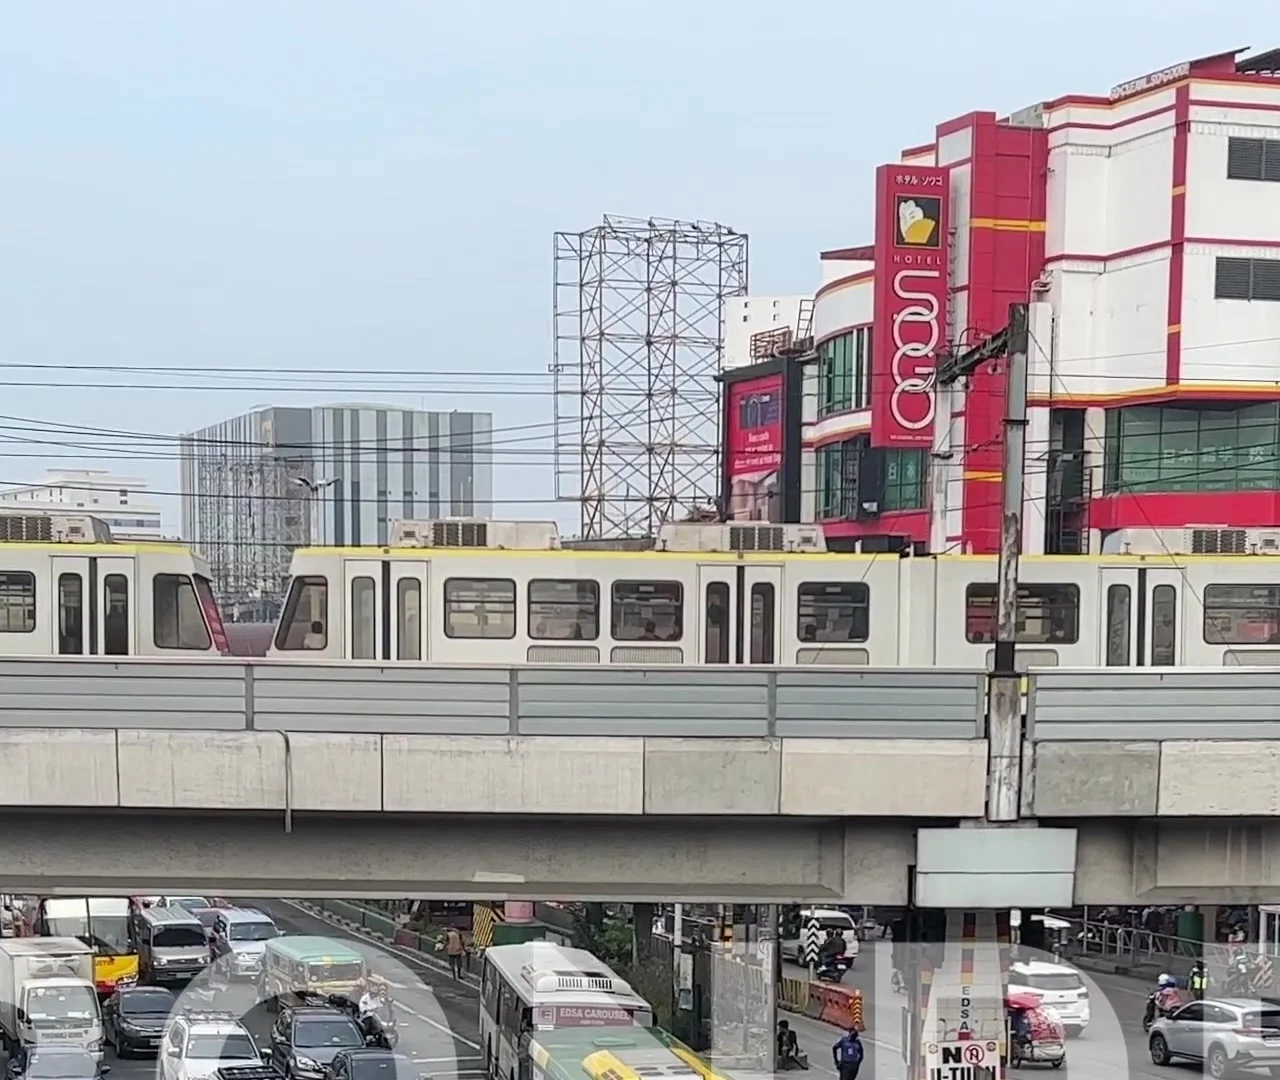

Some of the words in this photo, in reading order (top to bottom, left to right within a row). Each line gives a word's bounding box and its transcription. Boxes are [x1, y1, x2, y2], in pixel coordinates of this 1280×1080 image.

[893, 254, 941, 266] HOTEL
[891, 270, 940, 430] SOGO
[560, 1008, 583, 1018] EDSA
[584, 1010, 630, 1020] CAROUSEL
[960, 986, 971, 1031] EDSA
